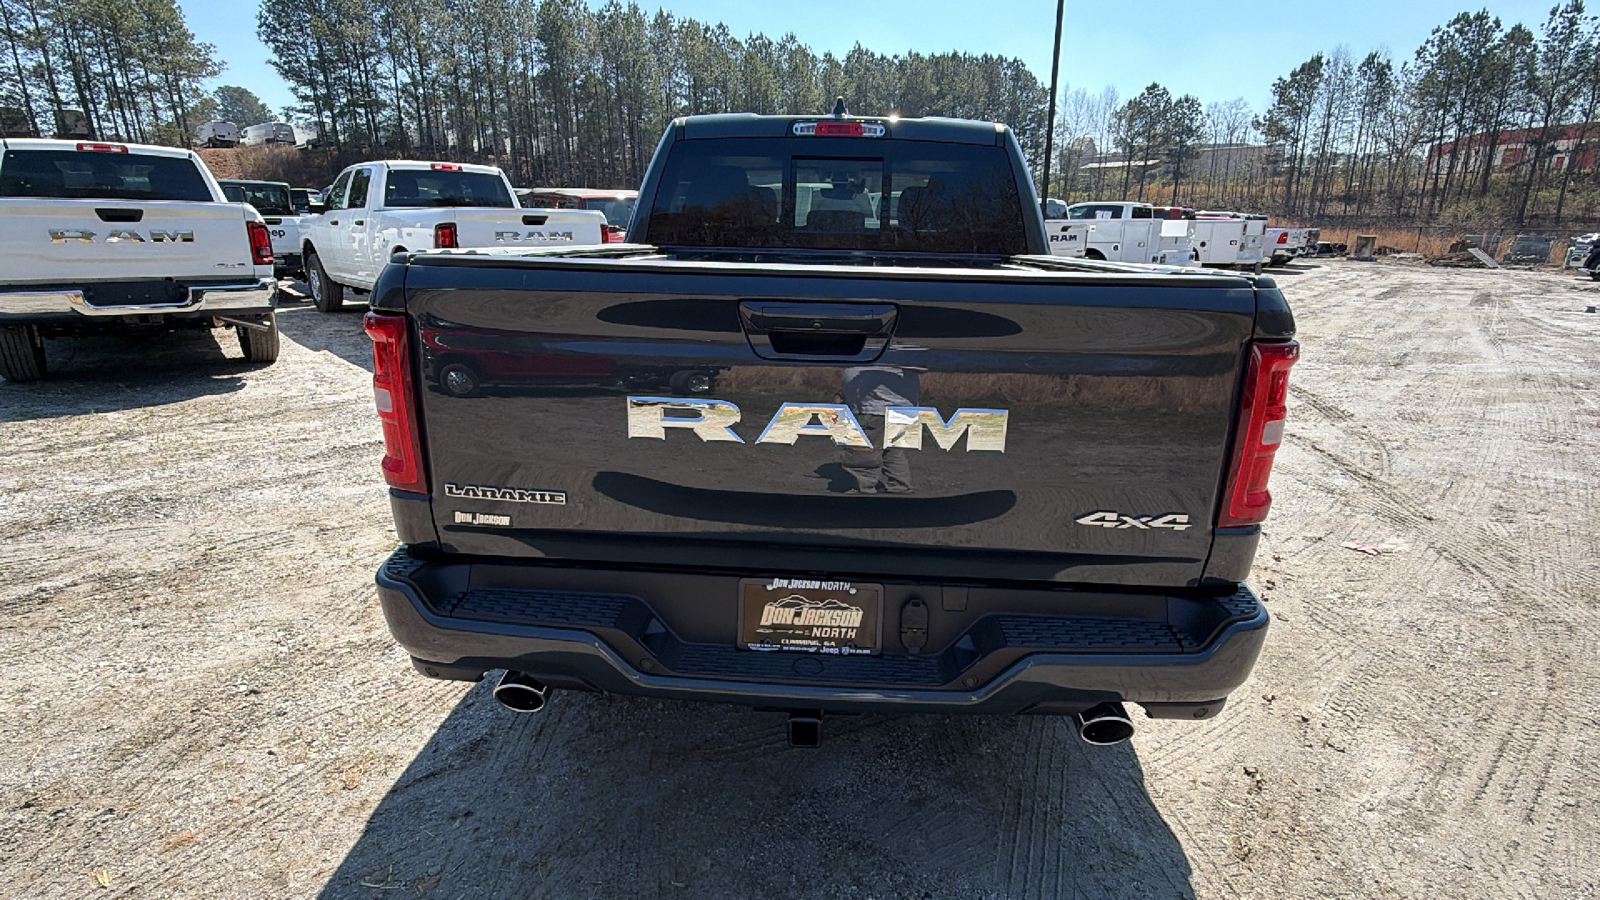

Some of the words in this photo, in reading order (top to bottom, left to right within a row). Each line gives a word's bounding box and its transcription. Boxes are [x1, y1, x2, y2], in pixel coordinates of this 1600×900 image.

[48, 228, 194, 243] RAM
[494, 231, 573, 243] RAM
[626, 395, 1009, 453] RAM
[445, 484, 566, 505] LARAMIE
[821, 581, 850, 591] NORTH
[760, 605, 795, 626] DON
[793, 607, 863, 627] JACKSON
[811, 627, 857, 639] NORTH
[820, 646, 840, 654] Jeep
